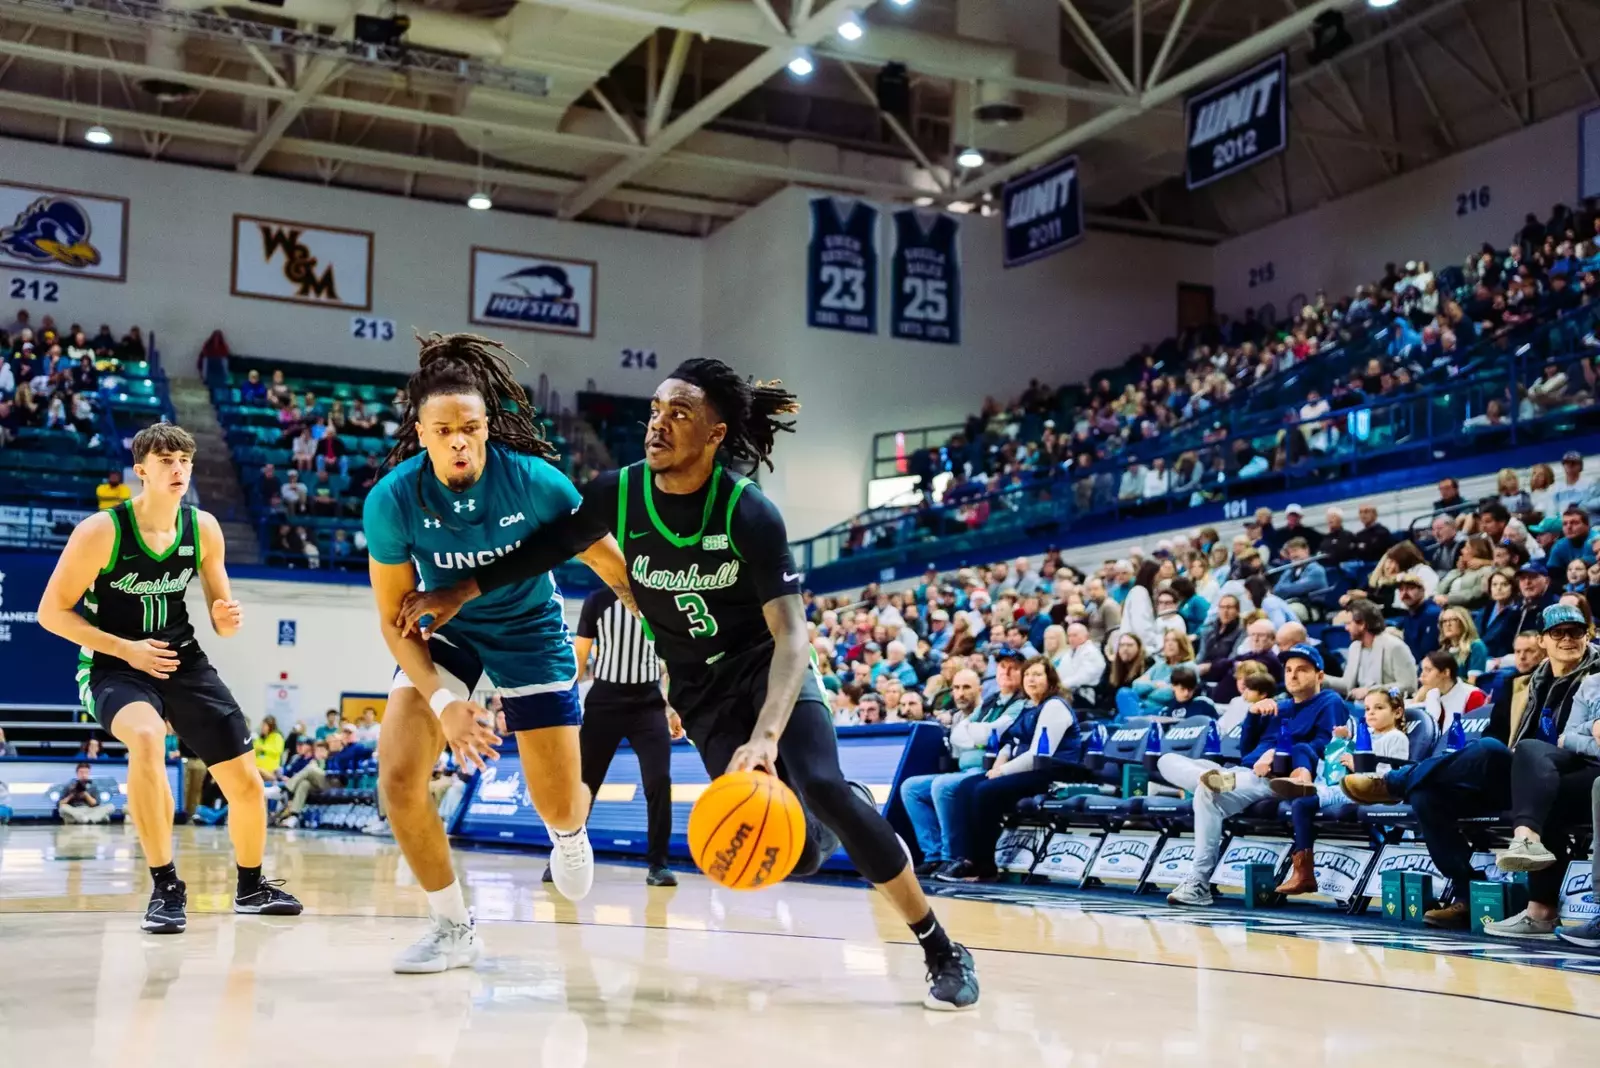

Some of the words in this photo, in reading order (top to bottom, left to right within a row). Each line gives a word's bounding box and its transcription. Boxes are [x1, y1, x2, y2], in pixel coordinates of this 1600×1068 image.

[1213, 129, 1257, 169] 2012
[1456, 185, 1491, 215] 216
[1028, 217, 1062, 248] 2011
[1248, 262, 1275, 287] 215
[10, 278, 59, 302] 212
[820, 265, 865, 311] 23
[903, 277, 947, 320] 25
[490, 297, 577, 319] HOFSTRA
[353, 318, 394, 340] 213
[621, 349, 657, 369] 214
[499, 512, 525, 527] CAA
[1223, 500, 1248, 518] 101
[702, 534, 729, 551] SBC
[110, 567, 193, 595] Marshall
[632, 555, 739, 592] Marshall
[141, 595, 167, 632] 11
[675, 592, 718, 640] 3
[1046, 841, 1090, 862] CAPITAL
[1101, 840, 1149, 861] CAPITAL
[1159, 845, 1195, 864] CAPI
[1314, 851, 1361, 880] APITAL
[1378, 854, 1440, 878] CAPIT
